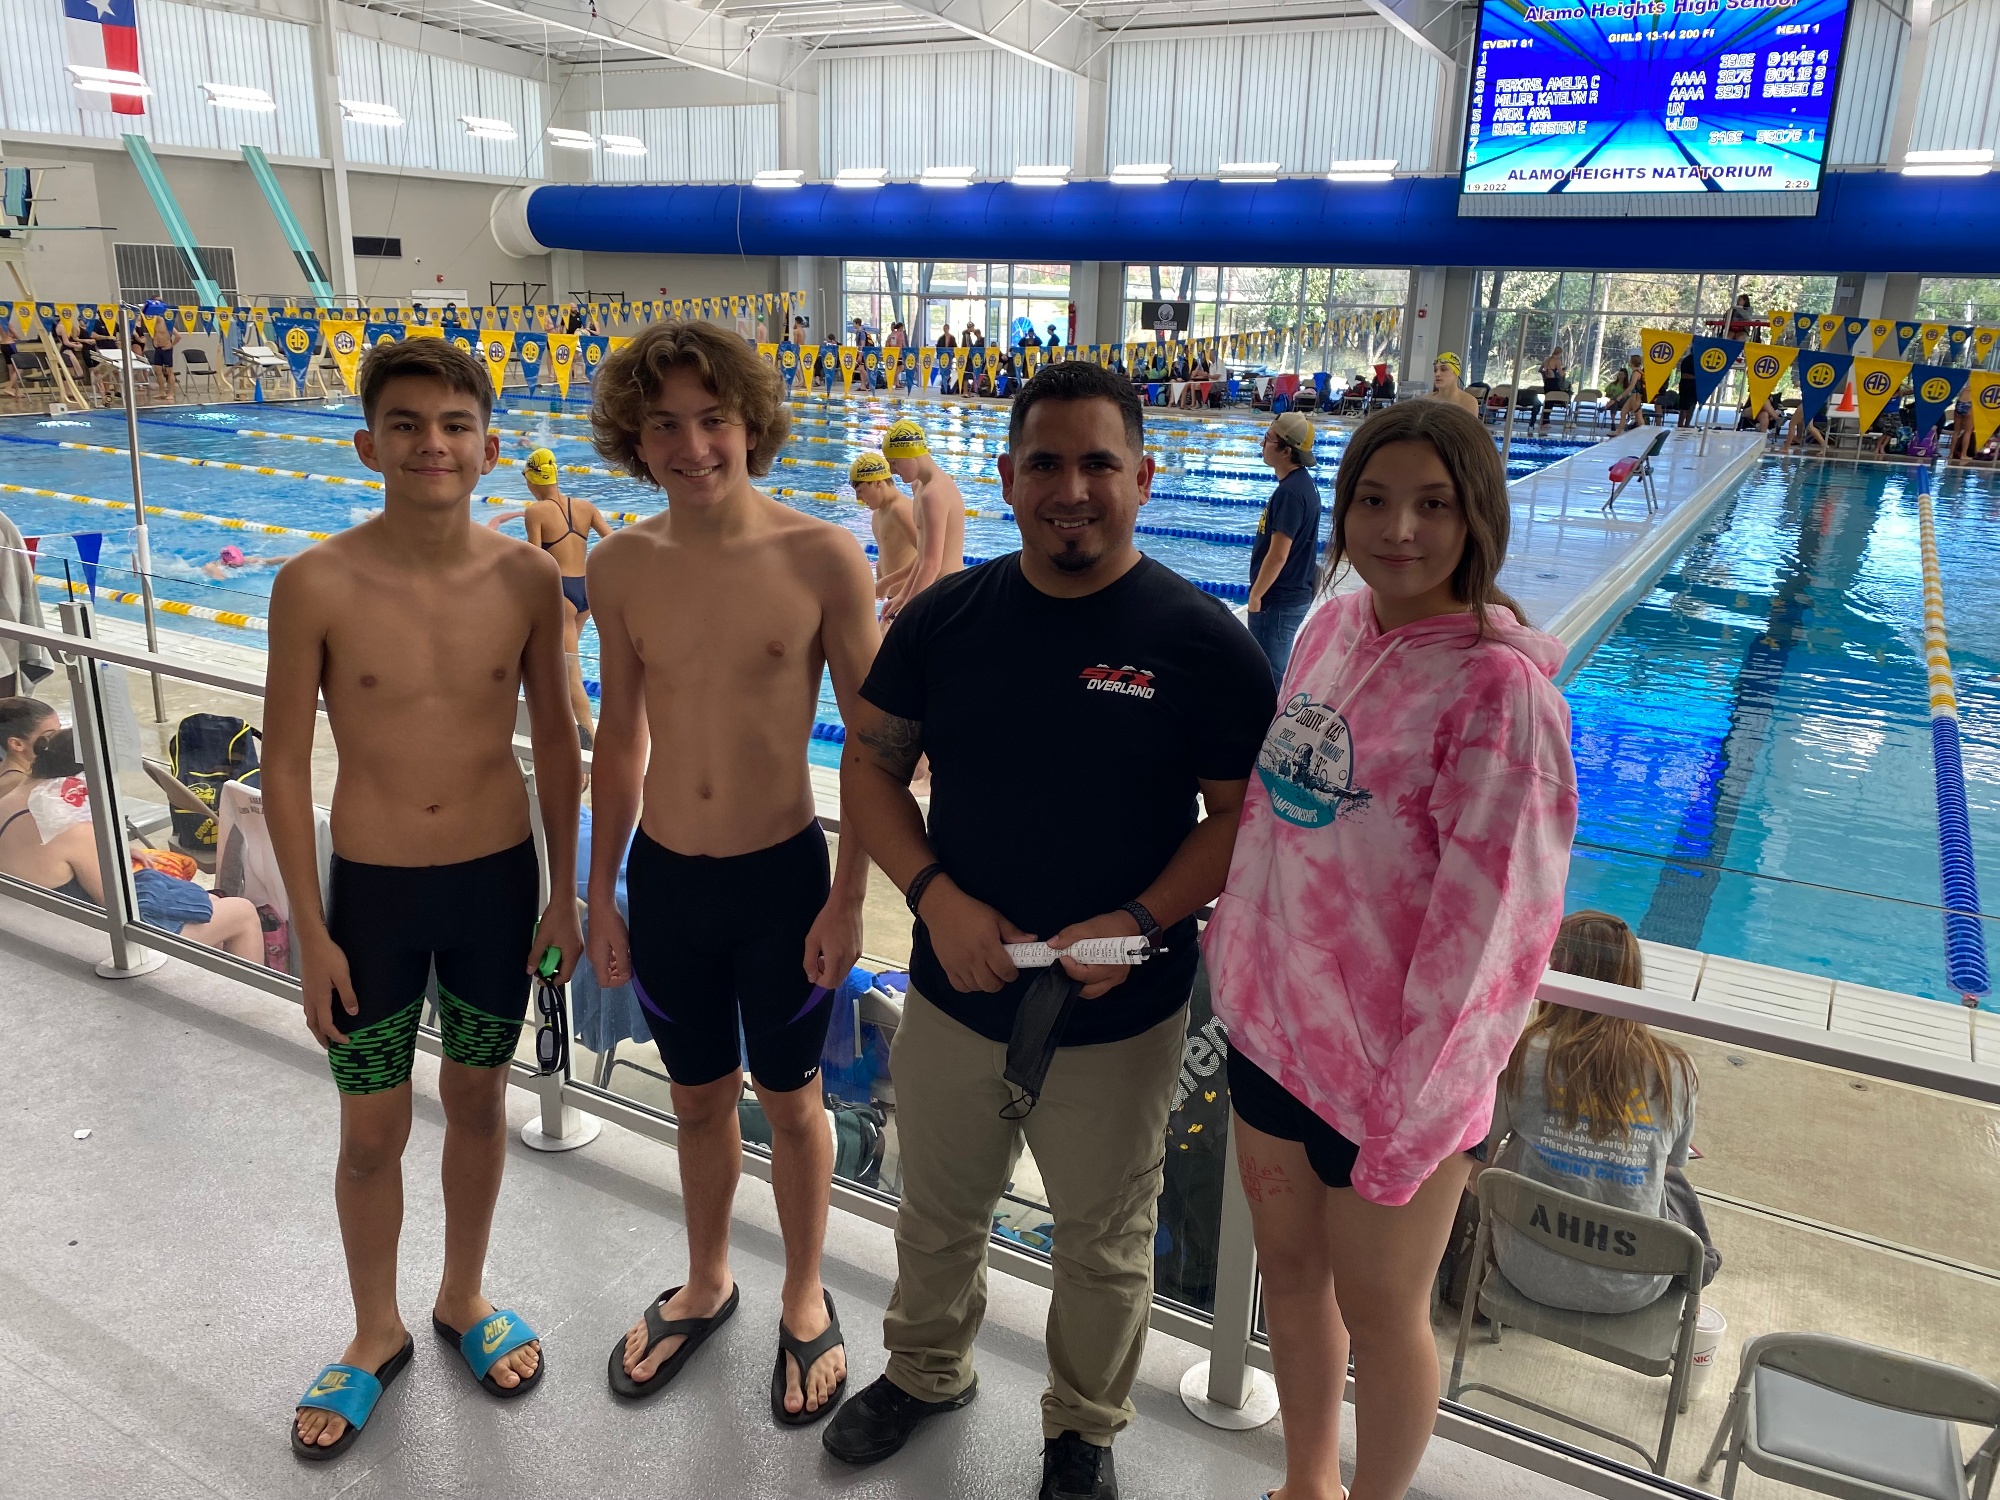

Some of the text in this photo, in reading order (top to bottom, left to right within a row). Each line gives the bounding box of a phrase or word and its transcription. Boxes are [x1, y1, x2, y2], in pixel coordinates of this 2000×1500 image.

[1524, 6, 1585, 22] Alamo
[1591, 1, 1666, 20] Heights
[1674, 0, 1718, 15] High
[1608, 32, 1642, 43] GIRLS
[1776, 24, 1810, 35] HEAT
[1482, 39, 1518, 49] EVENT
[1477, 66, 1486, 78] 2
[1817, 49, 1829, 64] 4
[1480, 51, 1487, 64] 1
[1475, 80, 1484, 93] 3
[1546, 76, 1588, 91] AMELIA
[1591, 75, 1600, 88] C
[1670, 70, 1707, 86] AAAA
[1814, 66, 1827, 80] 3
[1473, 94, 1483, 107] 4
[1537, 91, 1587, 106] KATELYN
[1668, 86, 1704, 101] AAAA
[1811, 81, 1824, 96] 2
[1472, 109, 1481, 122] 5
[1527, 107, 1551, 120] ANA
[1530, 121, 1576, 136] KRISTEN
[1577, 120, 1587, 134] E
[1469, 137, 1478, 150] 7
[1807, 129, 1815, 143] 1
[1508, 165, 1773, 181] ALAMO HEIGHTS NATATORIUM
[1784, 180, 1810, 189] 2:29
[1079, 667, 1154, 688] STX
[1087, 679, 1155, 699] OVERLAND
[1279, 728, 1296, 743] 2022
[1634, 1128, 1652, 1141] find
[1529, 1203, 1637, 1257] AHHS
[482, 1316, 510, 1341] NIKE
[1693, 1355, 1710, 1364] NIC
[320, 1371, 351, 1387] NIKE
